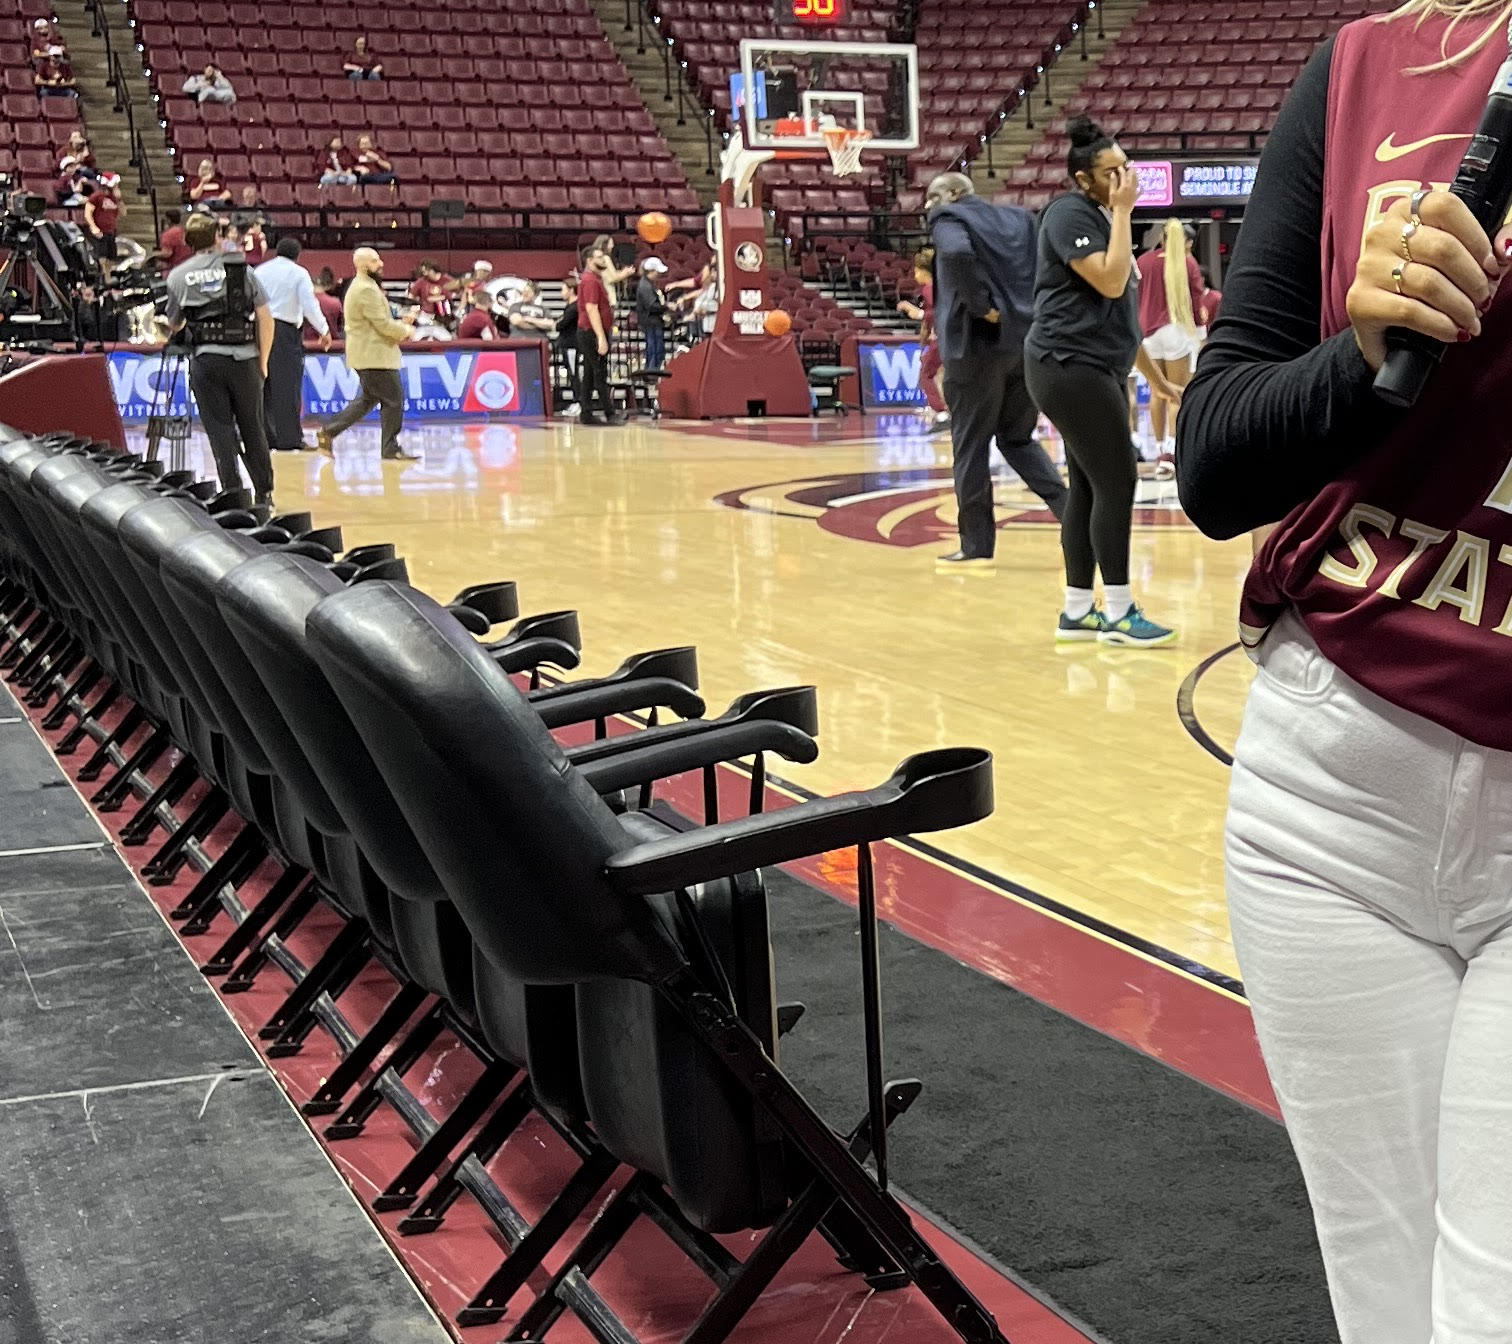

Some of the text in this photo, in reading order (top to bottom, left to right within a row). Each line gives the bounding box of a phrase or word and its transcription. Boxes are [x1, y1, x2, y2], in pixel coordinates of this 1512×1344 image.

[184, 266, 227, 287] CREW
[304, 354, 473, 401] WTV
[416, 398, 460, 411] NEWS
